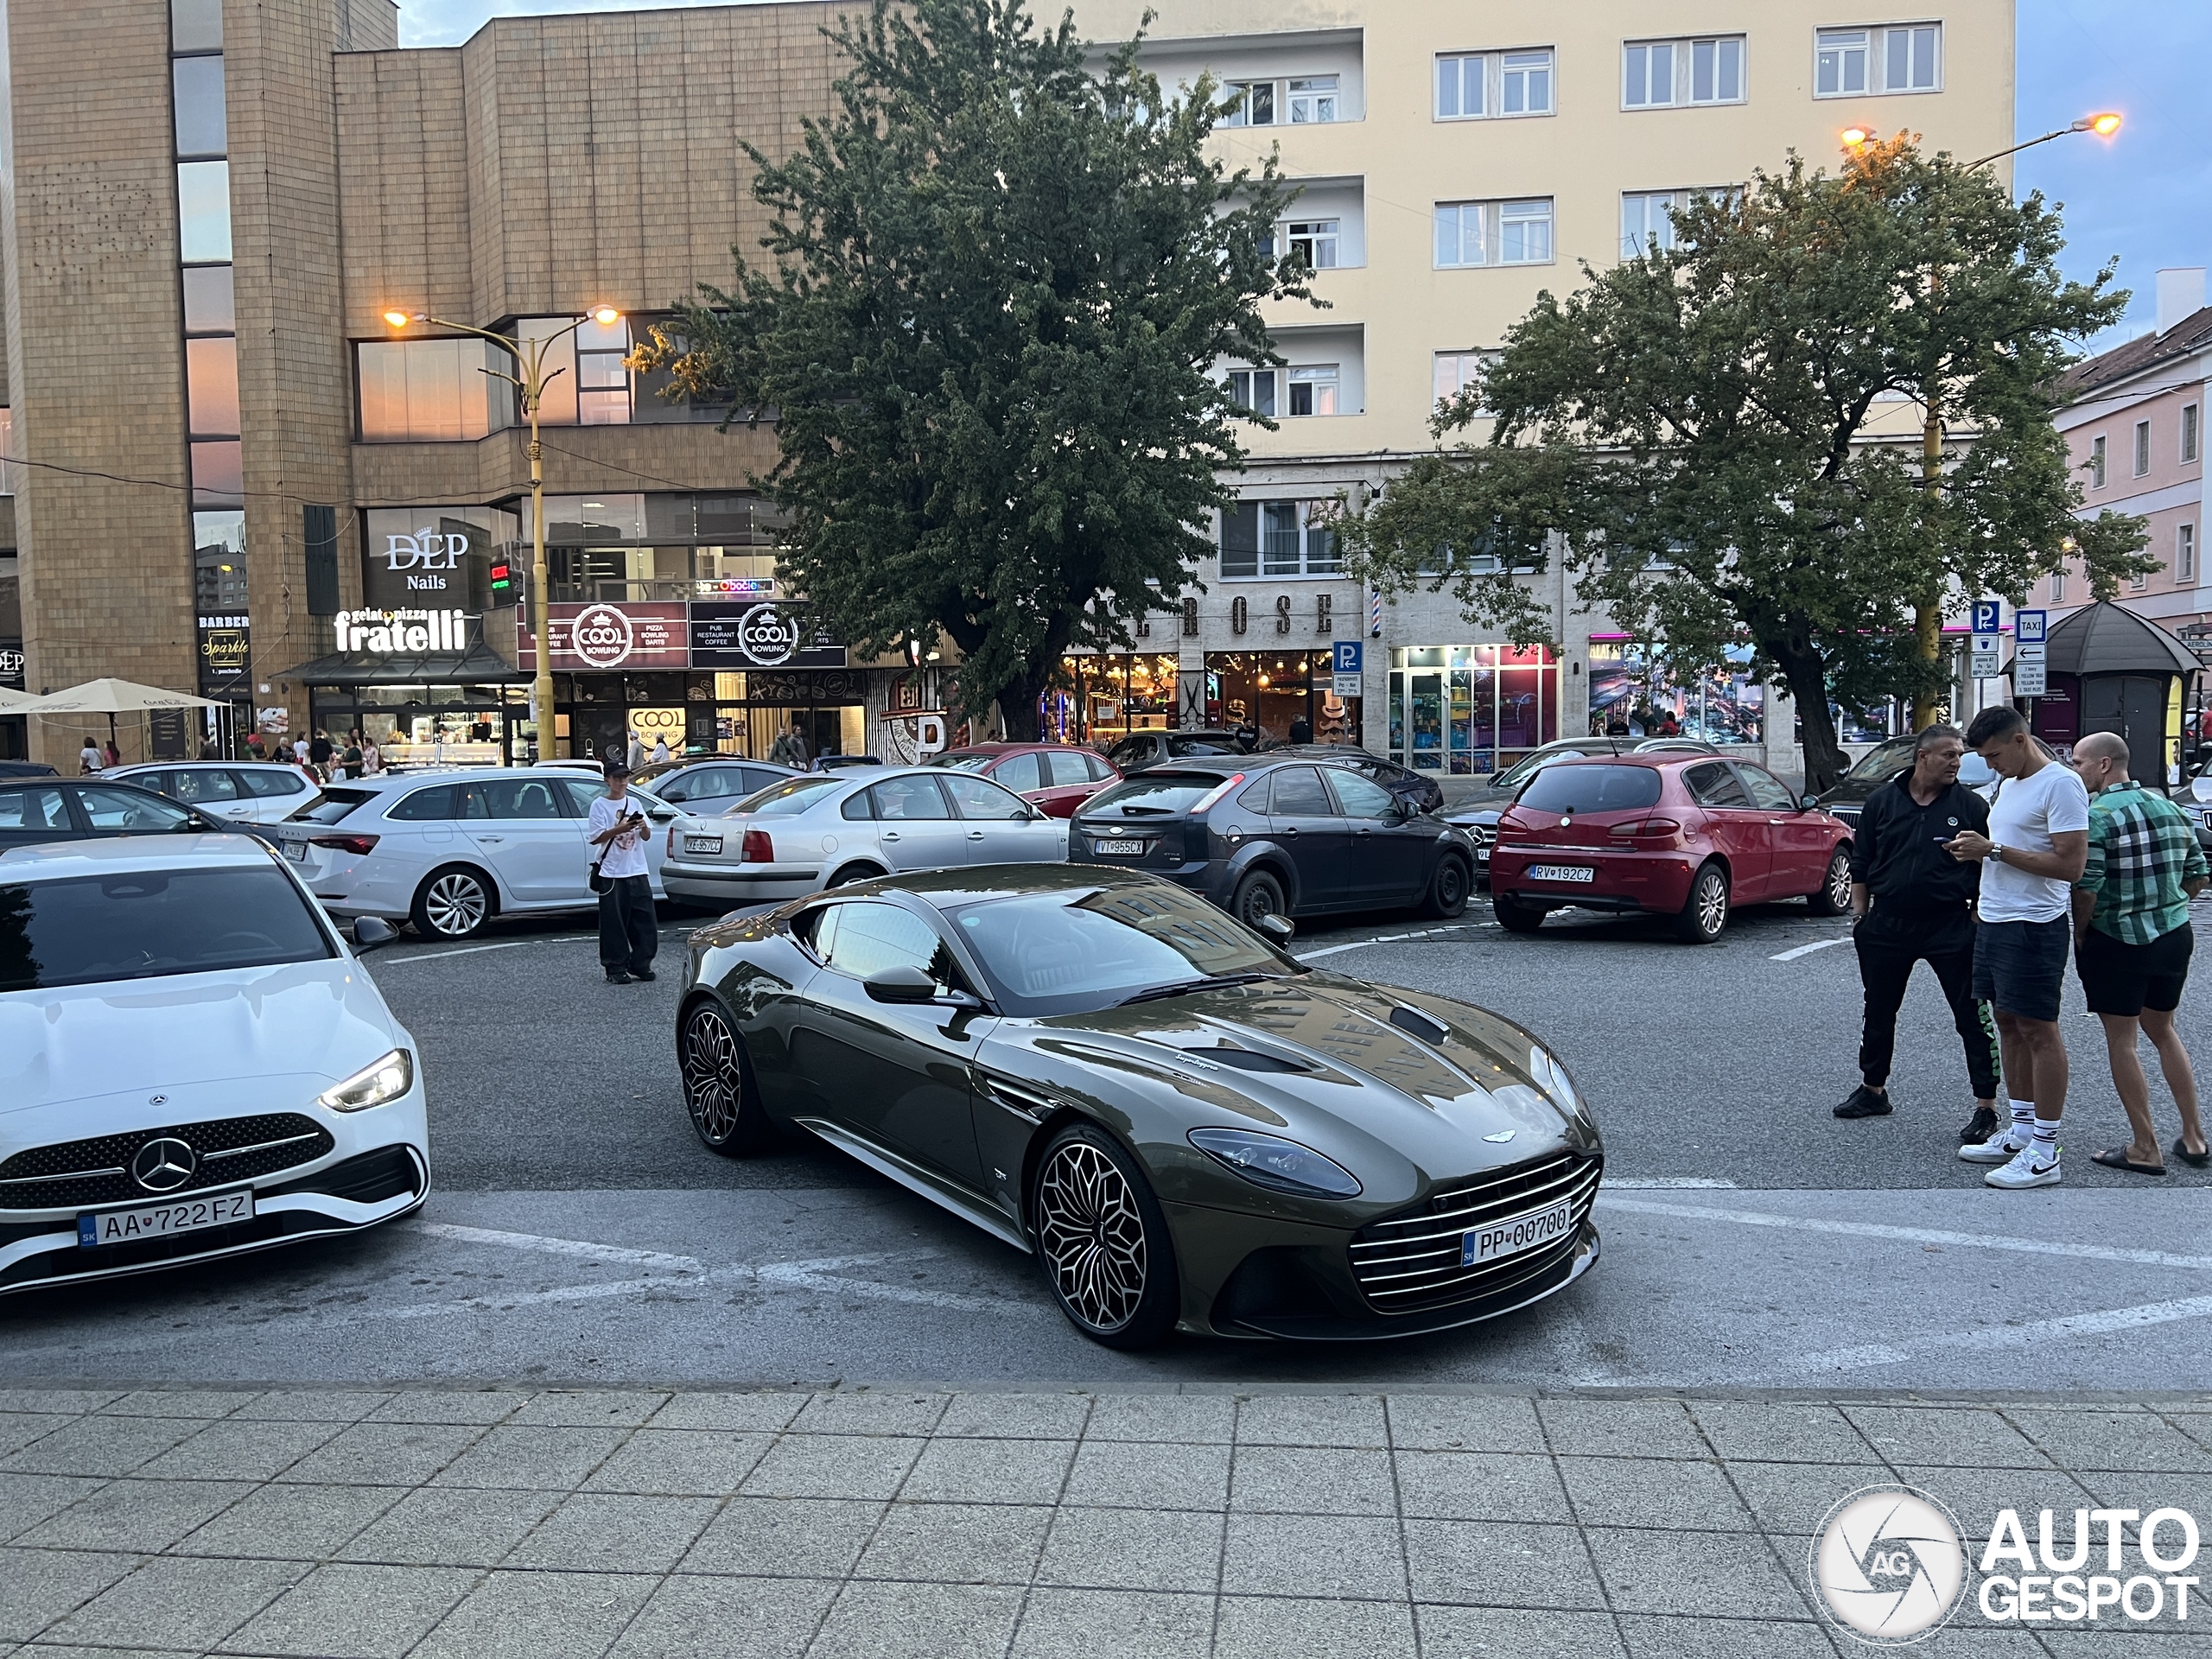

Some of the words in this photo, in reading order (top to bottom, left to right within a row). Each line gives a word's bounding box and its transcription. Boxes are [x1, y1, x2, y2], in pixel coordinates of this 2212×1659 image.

[407, 575, 447, 590] Nails
[199, 616, 250, 628] BARBER
[394, 607, 428, 623] pizza
[1978, 605, 1993, 630] P
[334, 608, 466, 652] fratelli
[744, 626, 792, 643] COOL
[2022, 621, 2041, 631] TAXI
[578, 627, 626, 645] COOL
[201, 637, 249, 658] Sparkle
[586, 645, 620, 655] BOWLING
[1339, 645, 1356, 668] P
[0, 651, 24, 671] EP
[633, 710, 685, 728] COOL
[156, 1196, 246, 1230] 722FZ
[1464, 1252, 1473, 1262] SK
[1514, 1208, 1567, 1246] 00700
